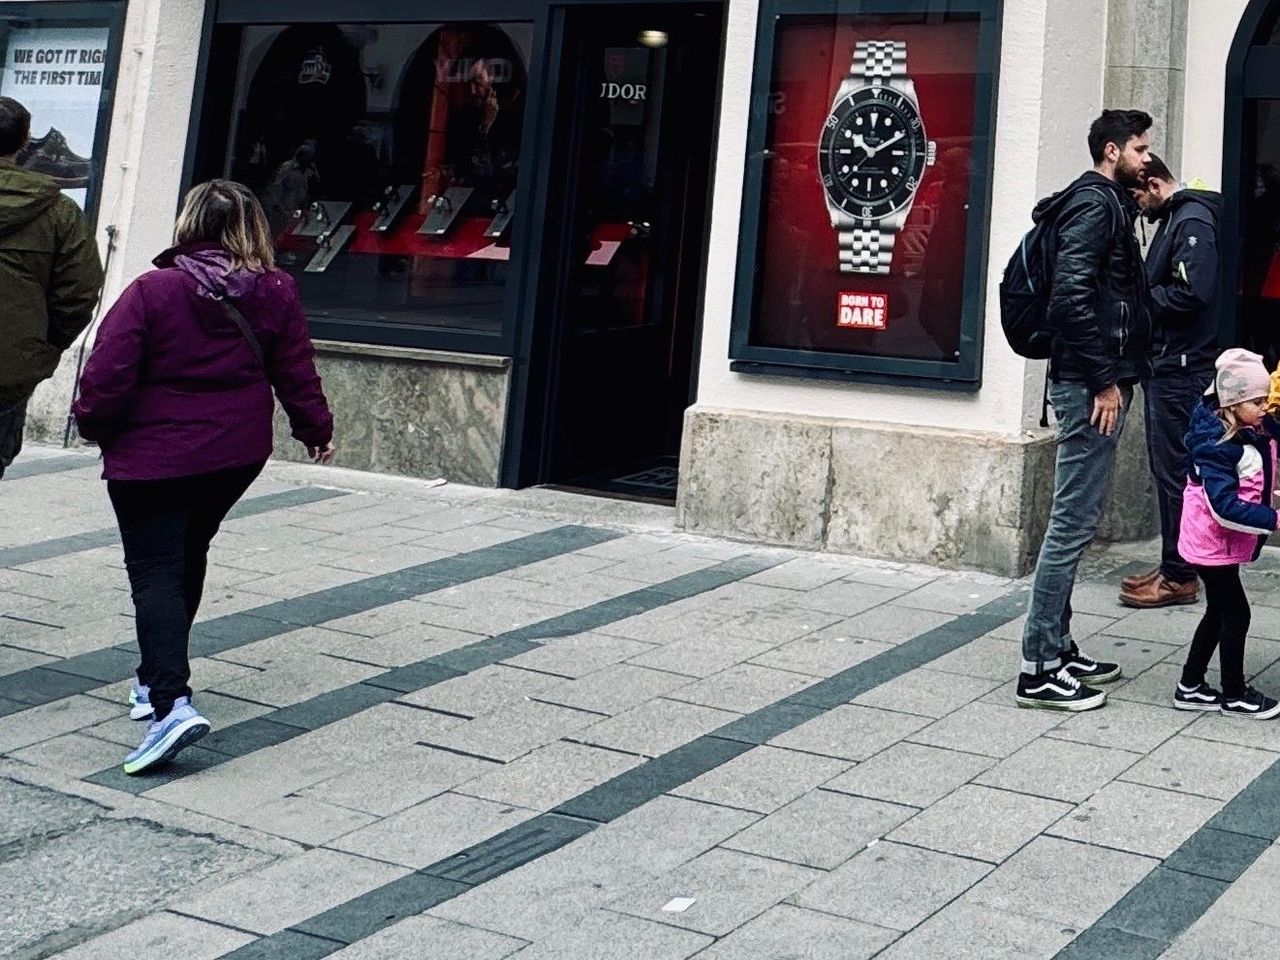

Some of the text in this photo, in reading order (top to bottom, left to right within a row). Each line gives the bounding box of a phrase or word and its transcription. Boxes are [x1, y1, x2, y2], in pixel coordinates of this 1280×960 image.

[13, 49, 33, 64] WE
[35, 49, 63, 64] GOT
[64, 49, 77, 64] IT
[14, 70, 38, 85] THE
[39, 70, 75, 85] FIRST
[841, 294, 885, 308] BORN TO
[840, 306, 884, 327] DARE
